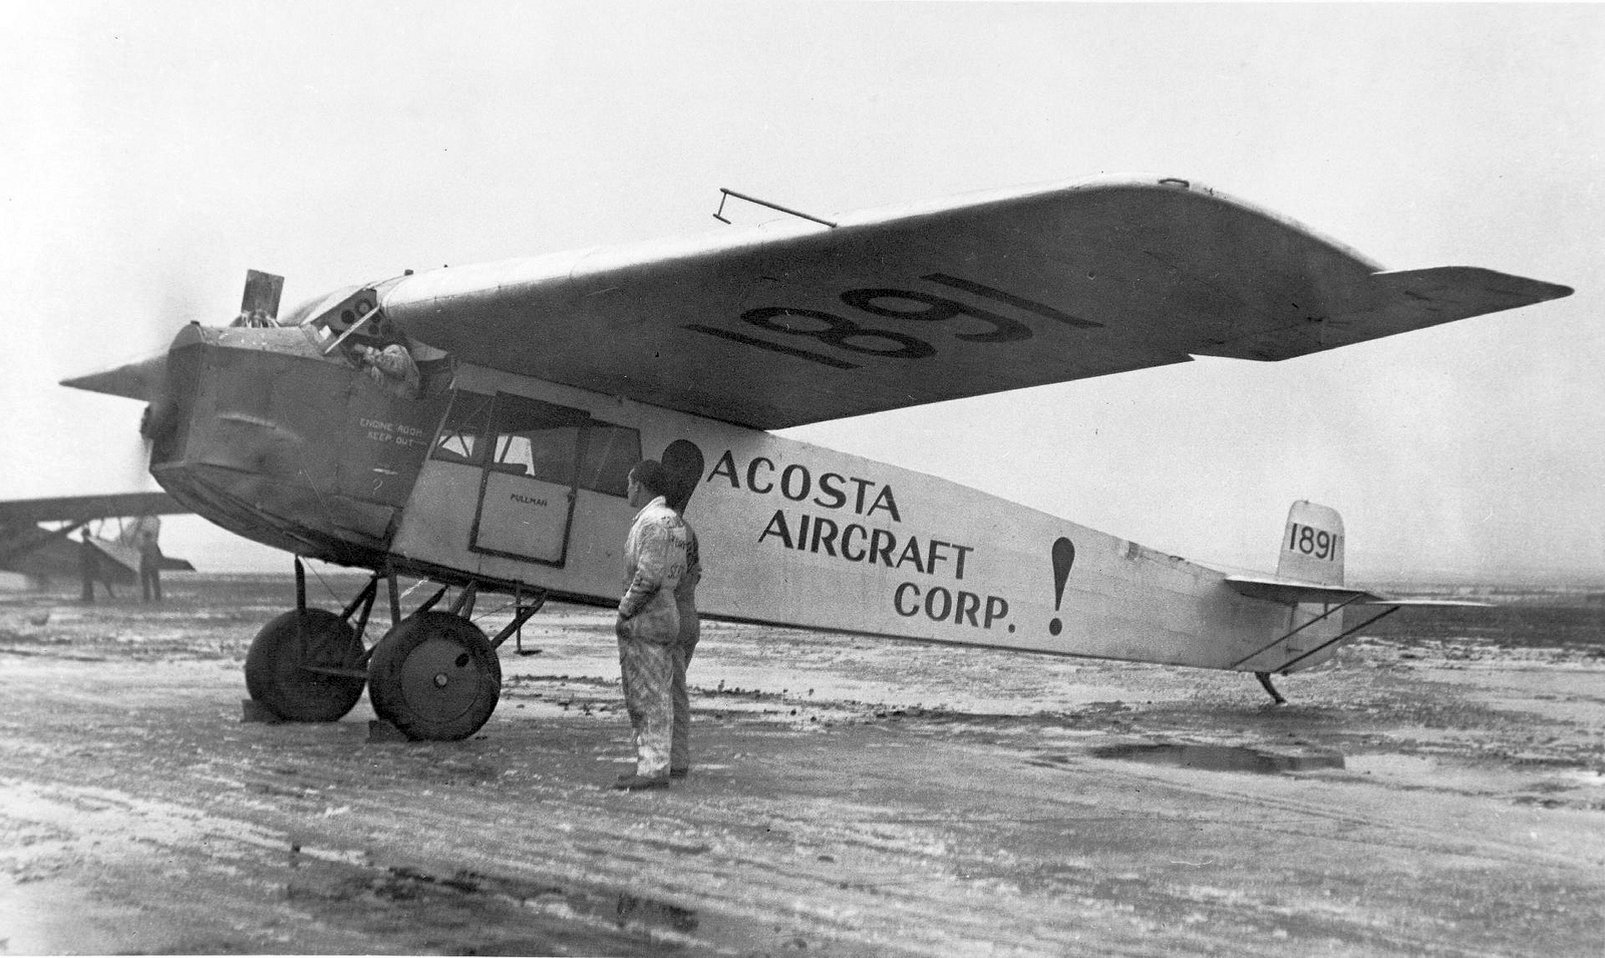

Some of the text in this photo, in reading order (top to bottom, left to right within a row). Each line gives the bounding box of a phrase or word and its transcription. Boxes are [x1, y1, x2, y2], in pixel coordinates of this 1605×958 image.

[678, 272, 1104, 370] 1891
[510, 493, 547, 507] PULLMAN
[707, 449, 901, 522] ACOSTA
[758, 509, 974, 580] AIRCRAFT
[1289, 522, 1337, 561] 1891
[894, 581, 1016, 634] CORP.
